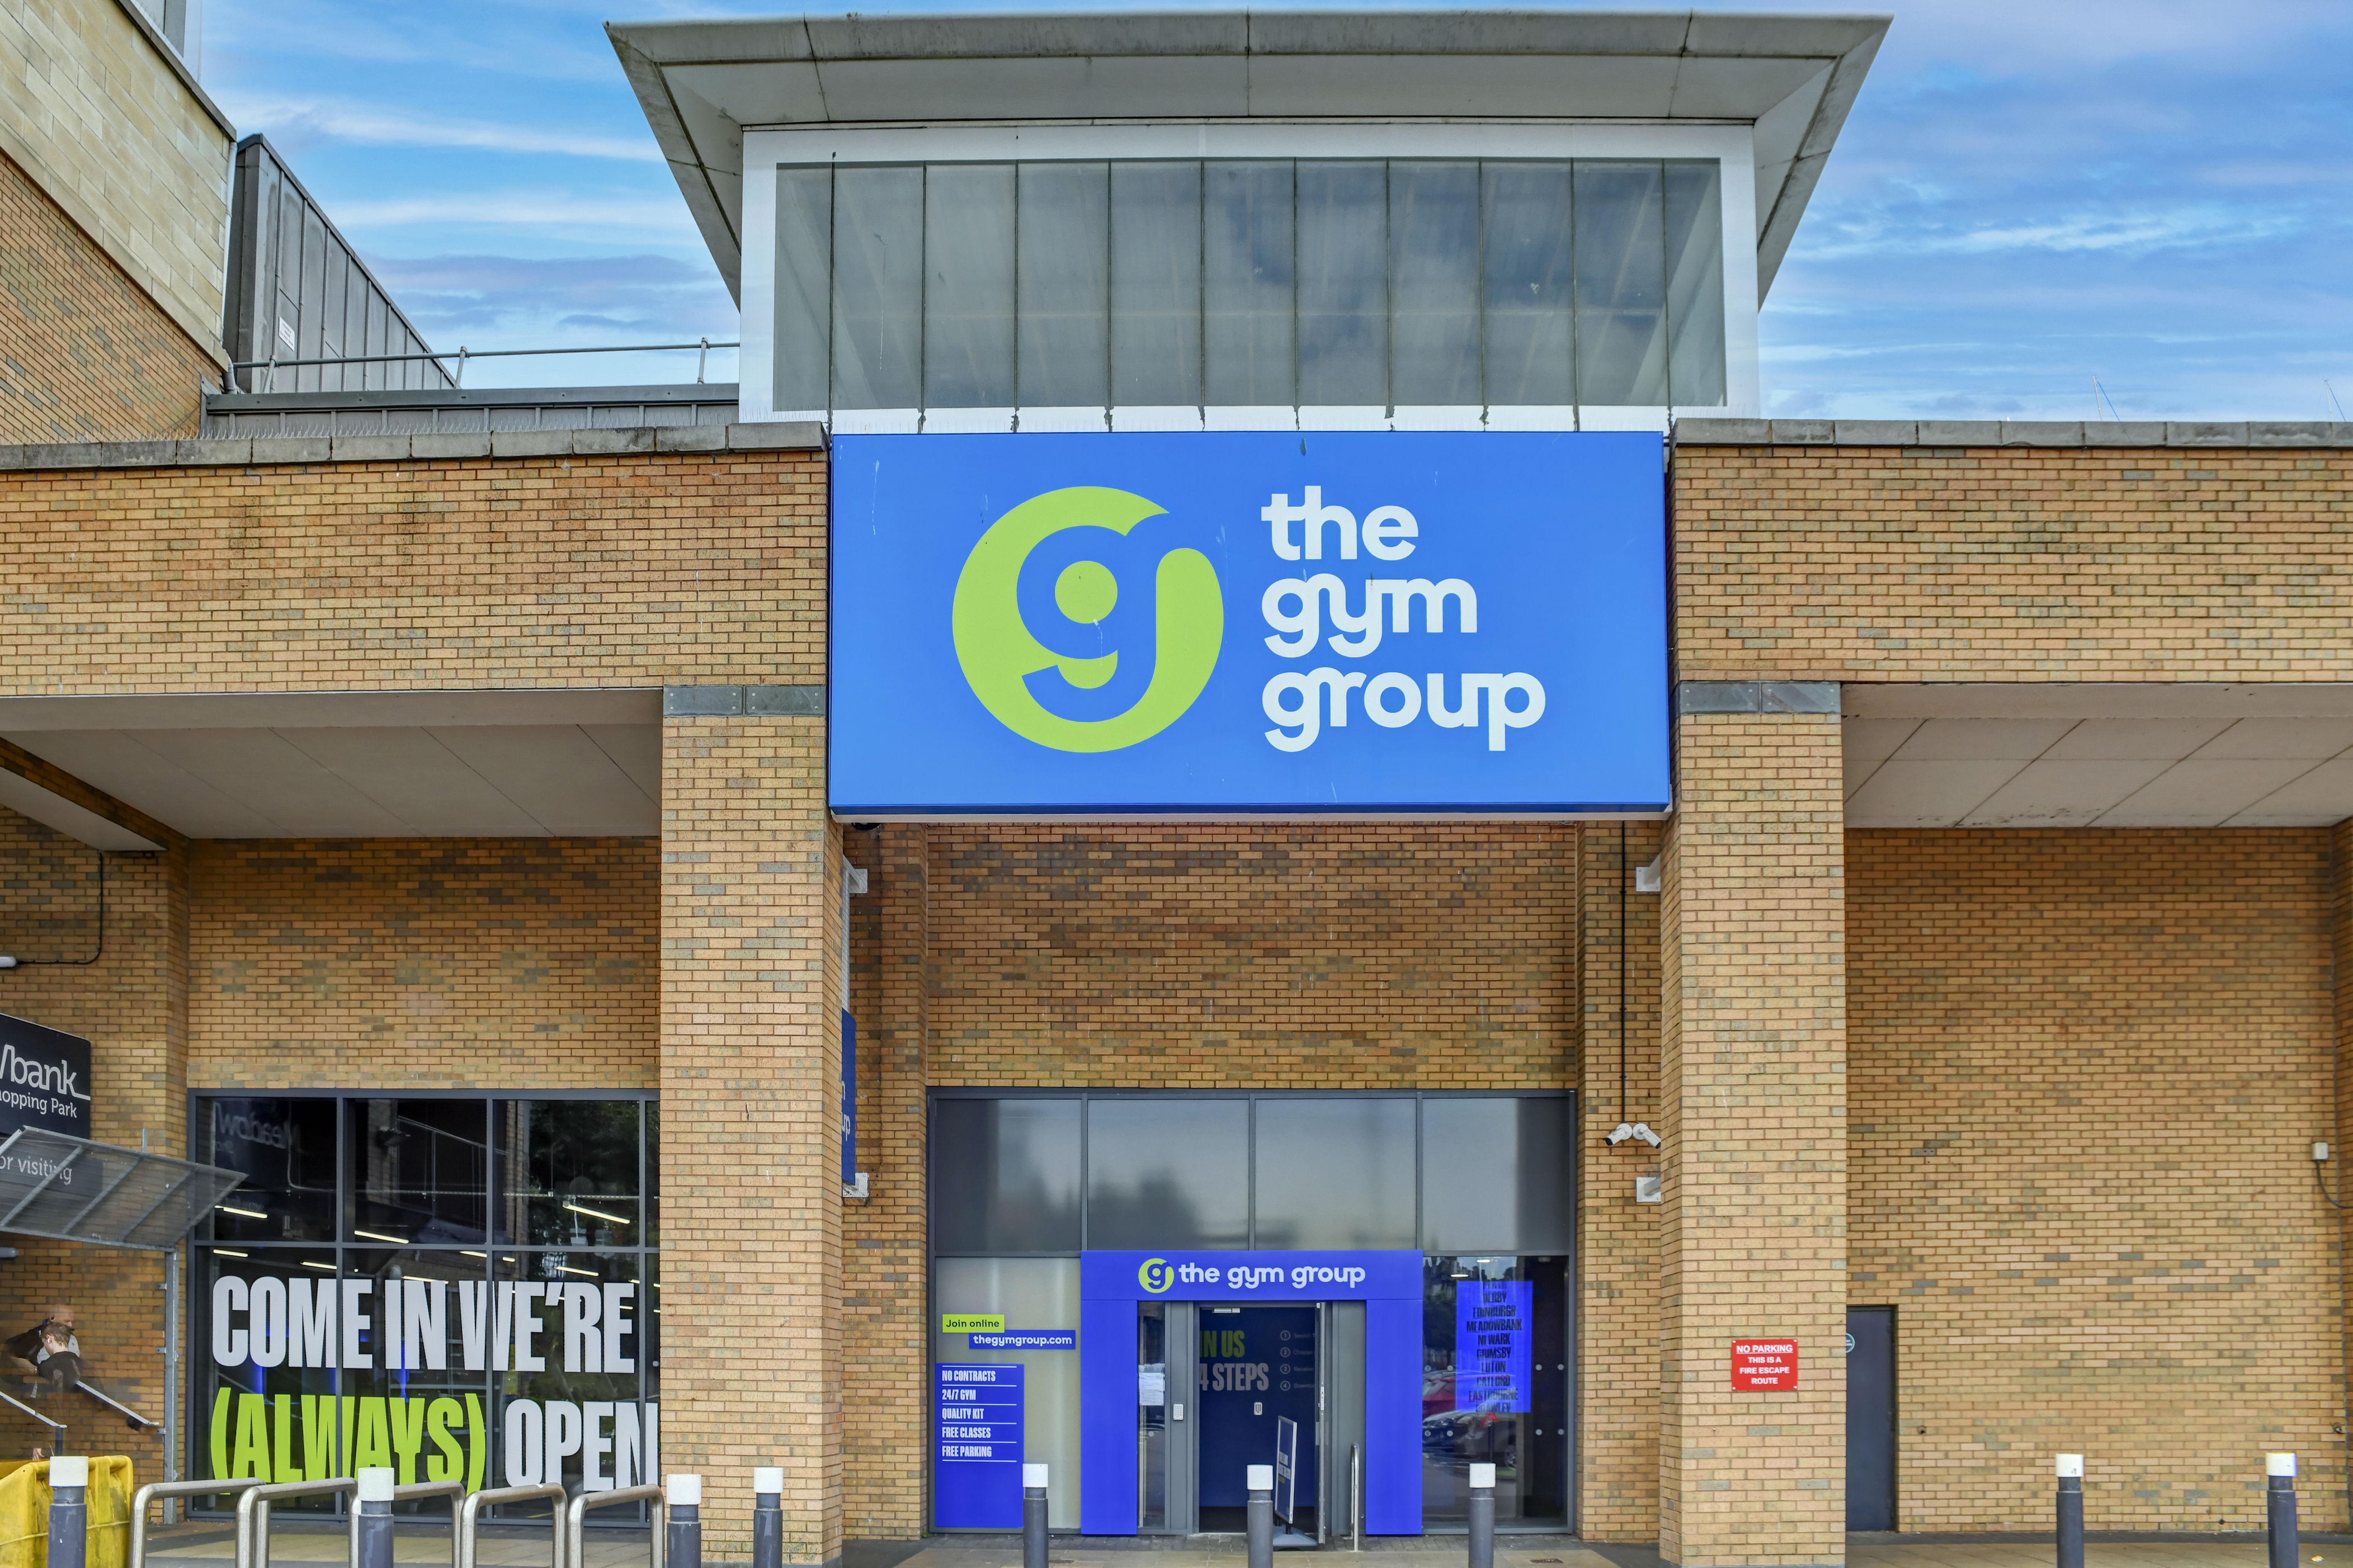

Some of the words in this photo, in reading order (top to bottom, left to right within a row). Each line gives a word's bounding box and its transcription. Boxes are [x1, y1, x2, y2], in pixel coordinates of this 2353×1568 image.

[1261, 485, 1419, 561] the
[1261, 573, 1478, 658] gym
[1261, 666, 1546, 752] group
[0, 1044, 91, 1101] bank
[0, 1090, 48, 1115] opping
[51, 1097, 77, 1118] Park
[18, 1156, 73, 1186] visitig
[1178, 1262, 1220, 1283] the
[1227, 1265, 1284, 1289] gym
[1291, 1265, 1366, 1289] group
[1483, 1291, 1507, 1303] DERBY
[1473, 1305, 1516, 1319] EDINBURGH
[212, 1276, 374, 1369] COME
[385, 1279, 447, 1371] IN
[946, 1319, 967, 1328] Join
[969, 1319, 1000, 1328] online
[1467, 1319, 1522, 1333] MEADOWBANK
[973, 1334, 1072, 1347] thegymgroup.com
[1200, 1330, 1217, 1358] IN
[1222, 1330, 1245, 1358] US
[1478, 1333, 1511, 1346] NEWARK
[1477, 1347, 1512, 1360] GRIMSBY
[1752, 1344, 1793, 1353] PARKING
[1482, 1361, 1506, 1373] LUTON
[942, 1370, 952, 1381] NO
[954, 1370, 996, 1382] CONTRACTS
[1199, 1363, 1209, 1391] 4
[1212, 1362, 1269, 1391] STEPS
[1477, 1375, 1511, 1387] CATFORD
[942, 1389, 959, 1400] 24/7
[960, 1389, 977, 1400] GYM
[1468, 1388, 1519, 1402] EASTBOURNE
[942, 1408, 972, 1420] QUALITY
[972, 1408, 984, 1419] KIT
[942, 1427, 959, 1438] FREE
[960, 1427, 991, 1438] CLASSES
[210, 1387, 485, 1497] (ALWAYS)
[505, 1399, 658, 1491] OPEN
[942, 1446, 959, 1457] FREE
[960, 1446, 992, 1457] PARKING
